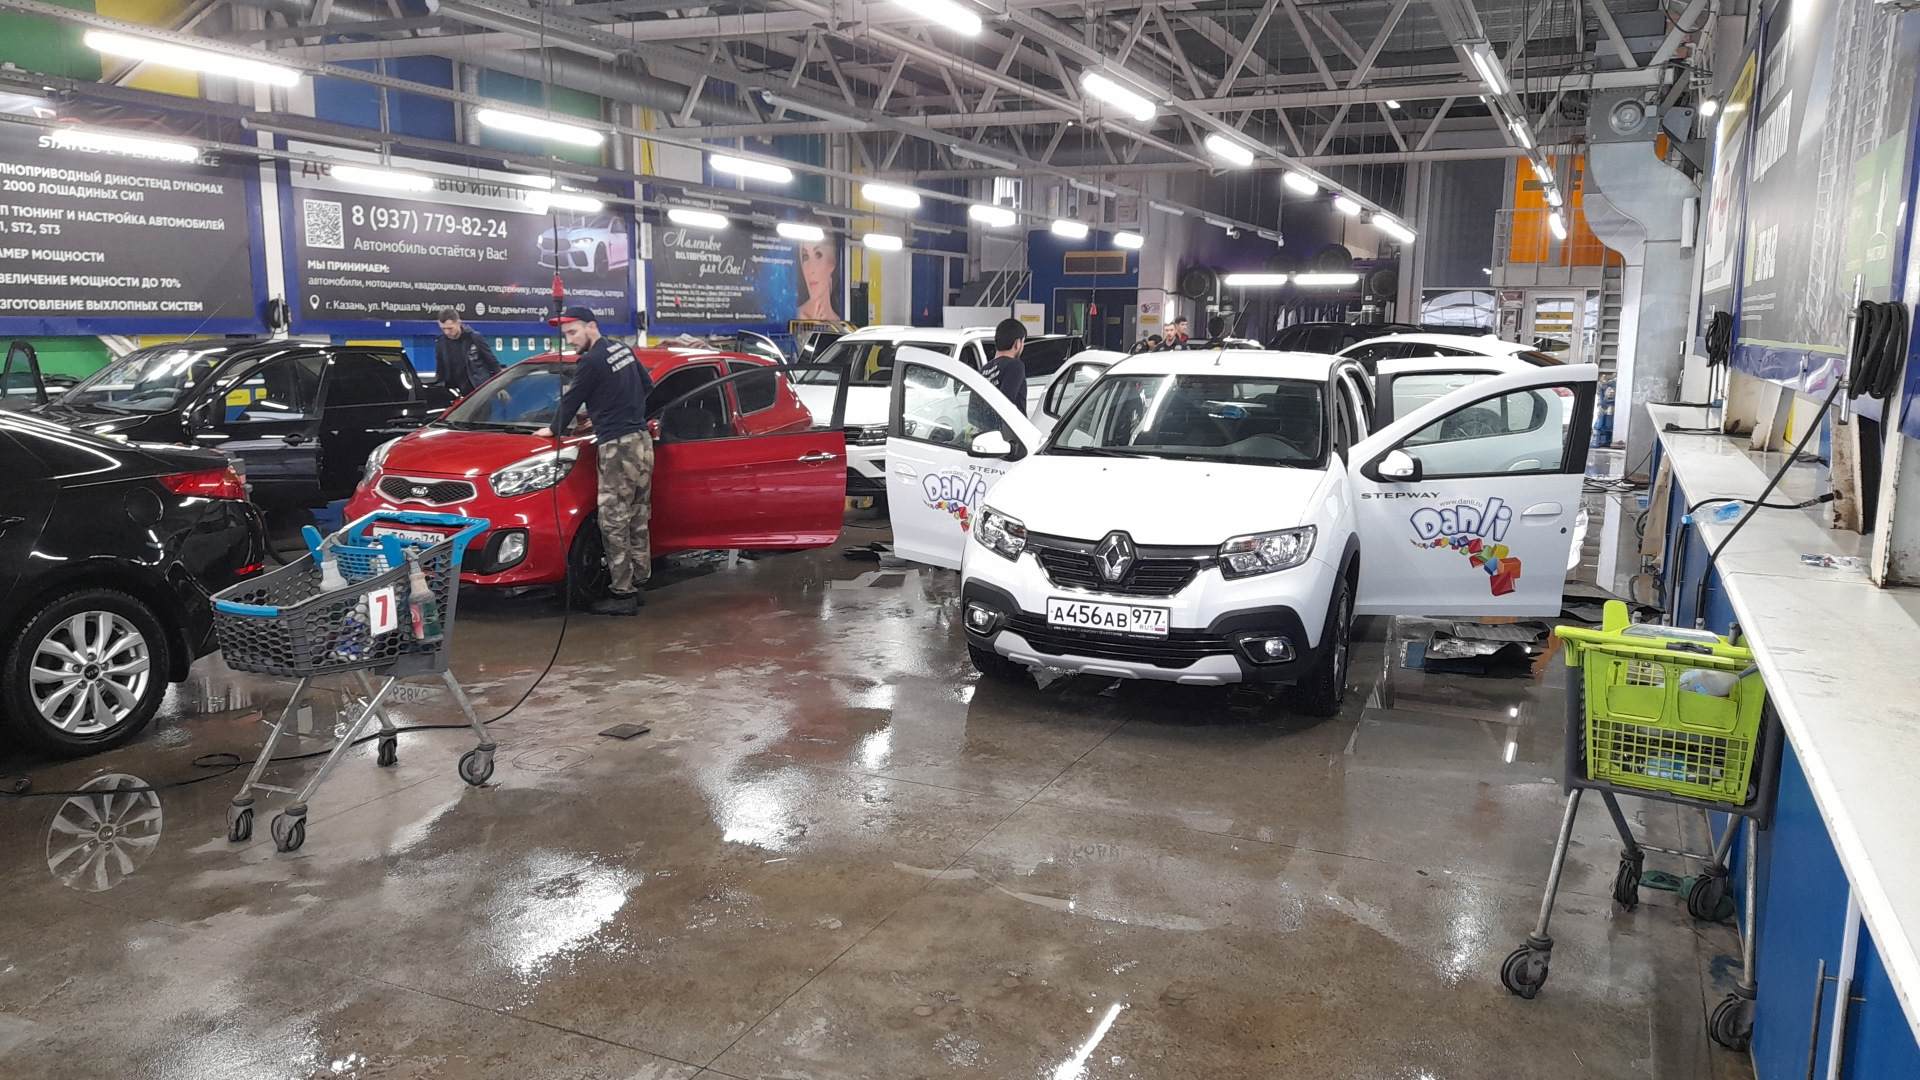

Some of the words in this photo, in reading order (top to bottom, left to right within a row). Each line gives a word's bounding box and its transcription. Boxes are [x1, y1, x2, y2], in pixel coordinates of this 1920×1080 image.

[3, 180, 36, 193] 2000
[38, 182, 119, 199] ЛОШАДИНЫХ
[120, 190, 145, 202] СИЛ
[104, 174, 171, 191] ДИНОСТЕНД
[173, 180, 224, 195] DYNOMAX
[11, 206, 64, 220] ТЮНИНГ
[66, 210, 76, 221] И
[78, 210, 147, 226] НАСТРОЙКА
[148, 216, 226, 231] АВТОМОБИЛЕЙ
[351, 205, 365, 226] 8
[370, 205, 418, 234] (937)
[423, 212, 508, 239] 779-82-24
[11, 222, 37, 235] ST2,
[39, 223, 61, 235] ST3
[31, 249, 105, 262] МОЩНОСТИ
[353, 237, 428, 255] Автомобиль
[429, 244, 476, 258] остаётся
[478, 249, 485, 262] у
[486, 247, 508, 261] Вас!
[307, 260, 325, 270] МЫ
[327, 261, 391, 273] ПРИНИМАЕМ:
[70, 275, 140, 288] МОЩНОСТИ
[141, 277, 159, 289] ДО
[160, 278, 182, 289] 70%
[308, 276, 365, 289] автомобили,
[366, 280, 414, 291] мотоциклы,
[86, 300, 159, 312] ВЫХЛОПНЫХ
[160, 301, 203, 312] СИСТЕМ
[333, 300, 367, 312] Казань,
[368, 303, 380, 313] ул.
[381, 302, 421, 313] Маршала
[455, 303, 466, 312] 40
[1439, 498, 1483, 508] www.danli.ru
[1410, 497, 1513, 542] Danli
[1132, 608, 1162, 626] 977
